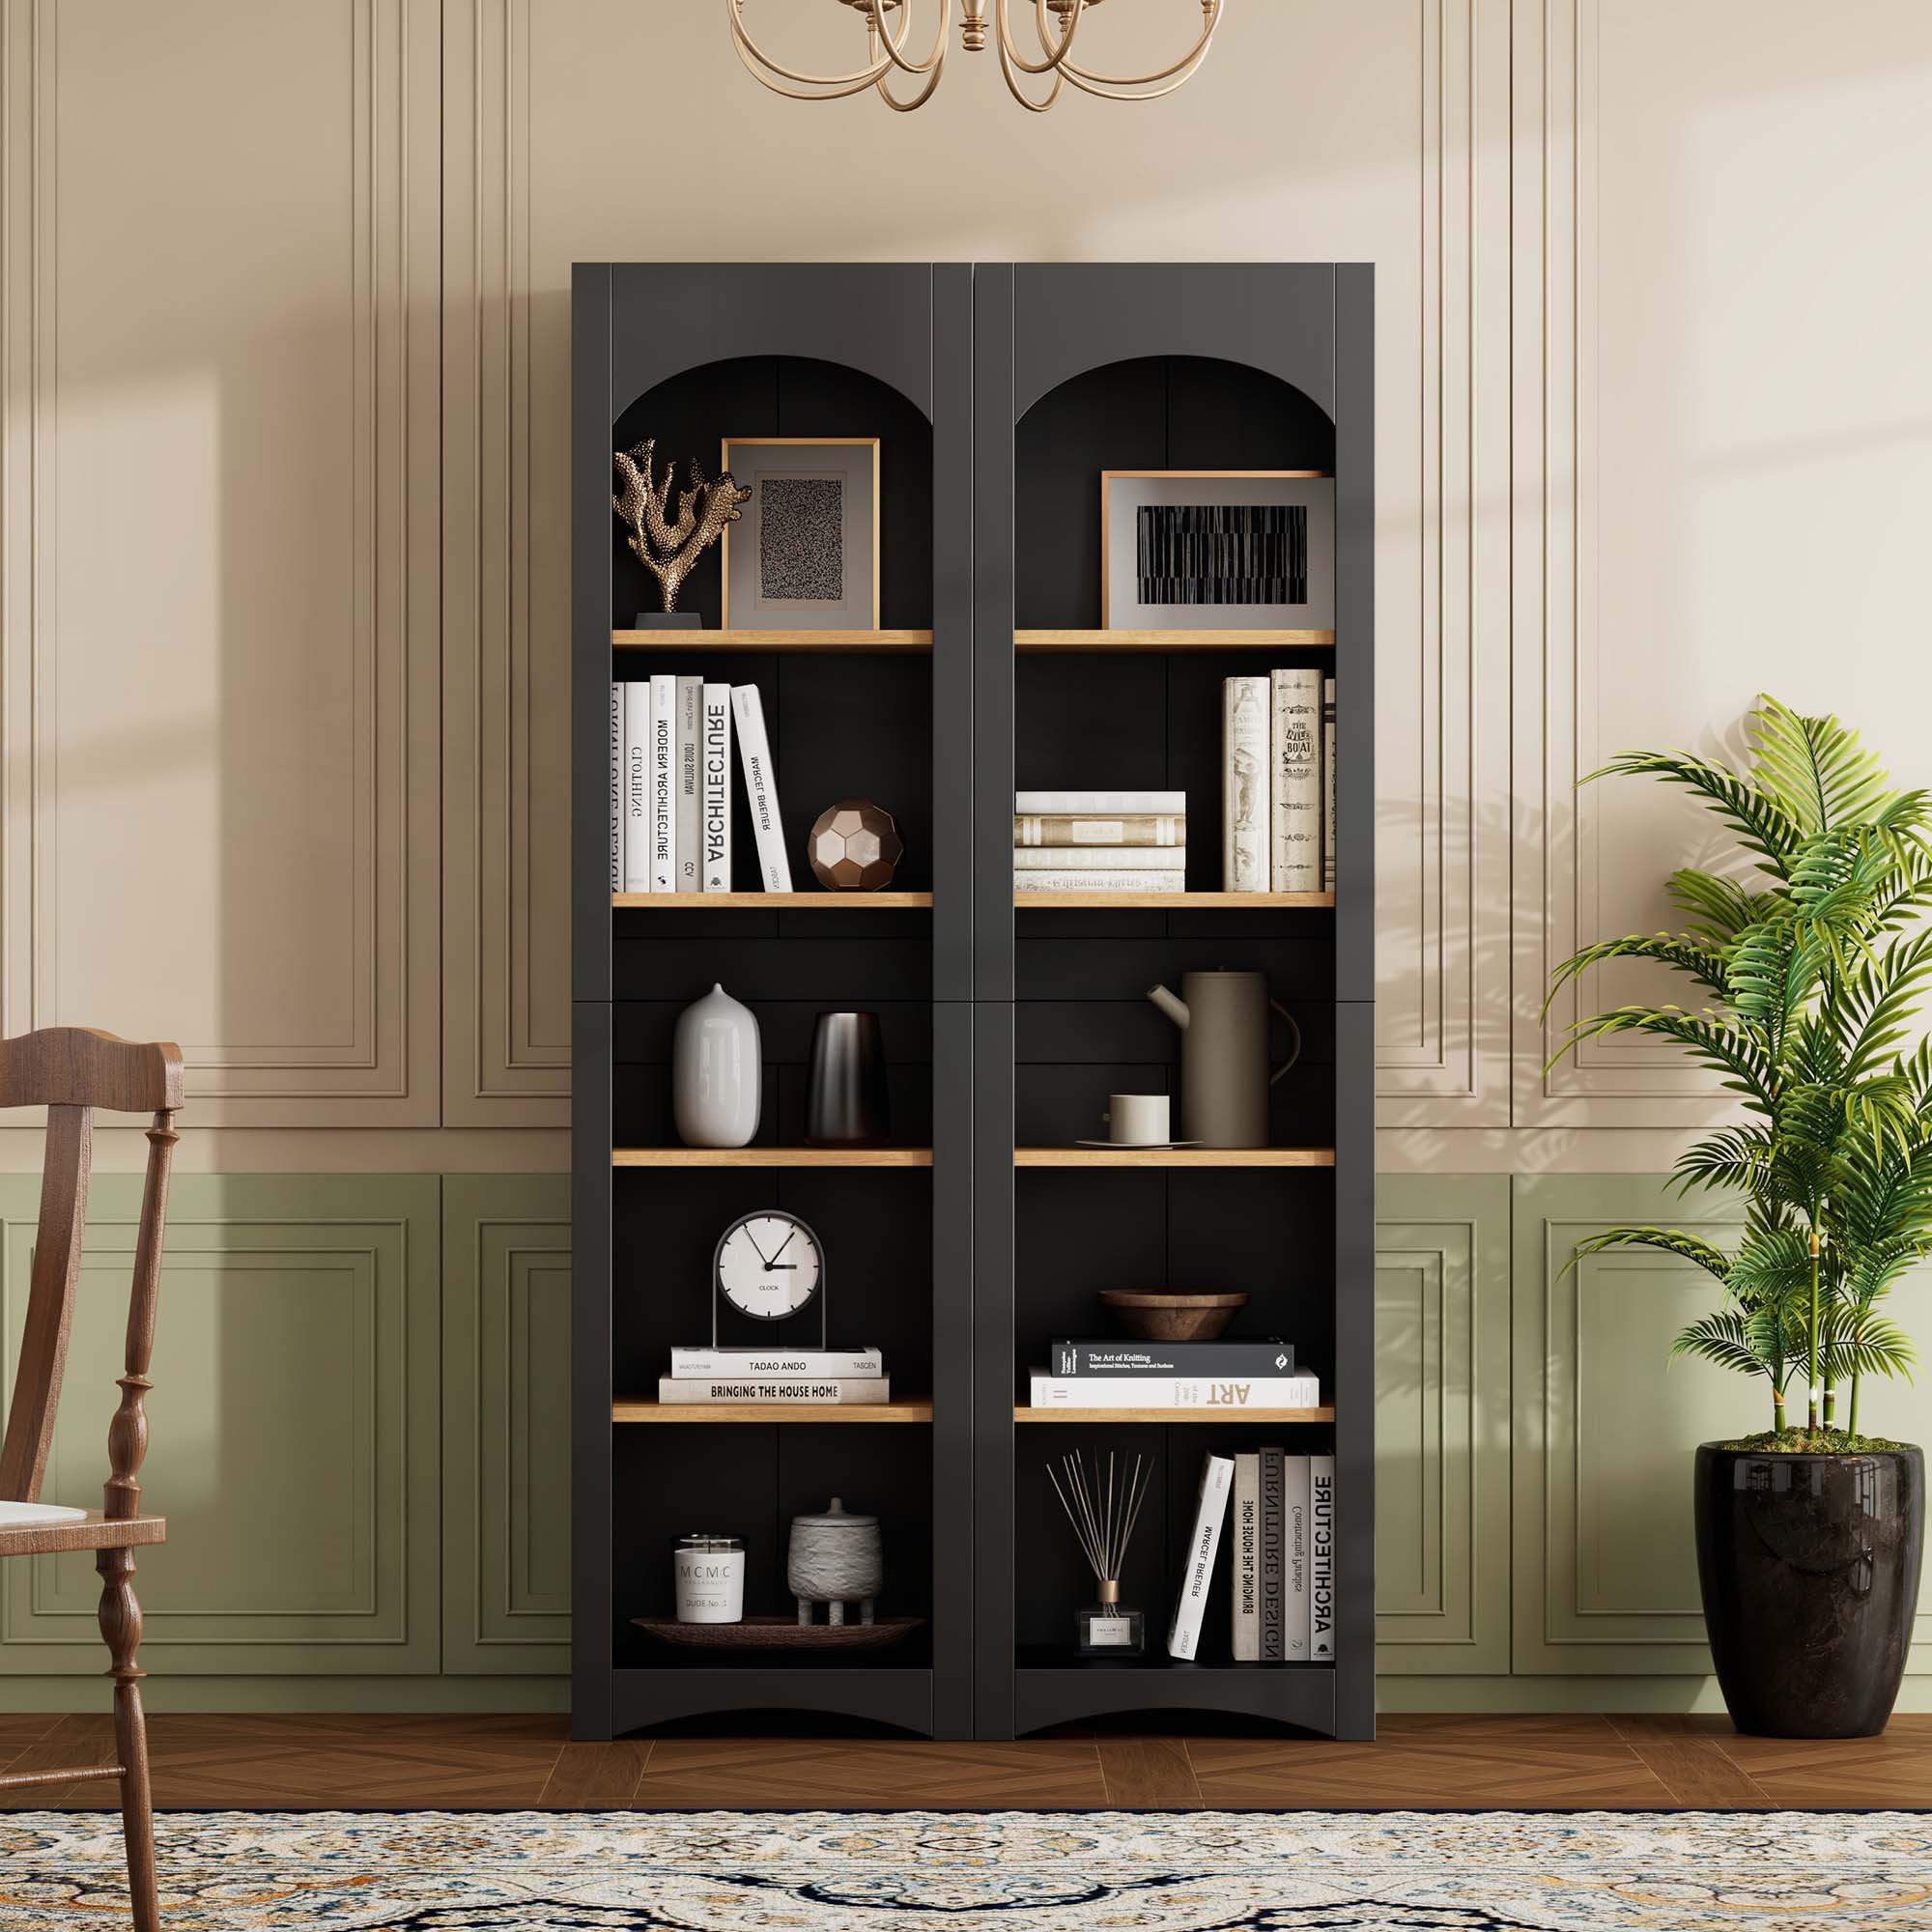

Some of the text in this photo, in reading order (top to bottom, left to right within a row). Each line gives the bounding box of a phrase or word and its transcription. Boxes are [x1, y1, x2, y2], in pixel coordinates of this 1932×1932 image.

[1287, 742, 1310, 752] BOAT
[1124, 1354, 1151, 1363] Knitting
[749, 1362, 806, 1371] TADAO ANDO
[711, 1386, 838, 1397] BRINGING THE HOUSE HOME
[1207, 1384, 1250, 1405] ART
[681, 1566, 731, 1578] MCMC
